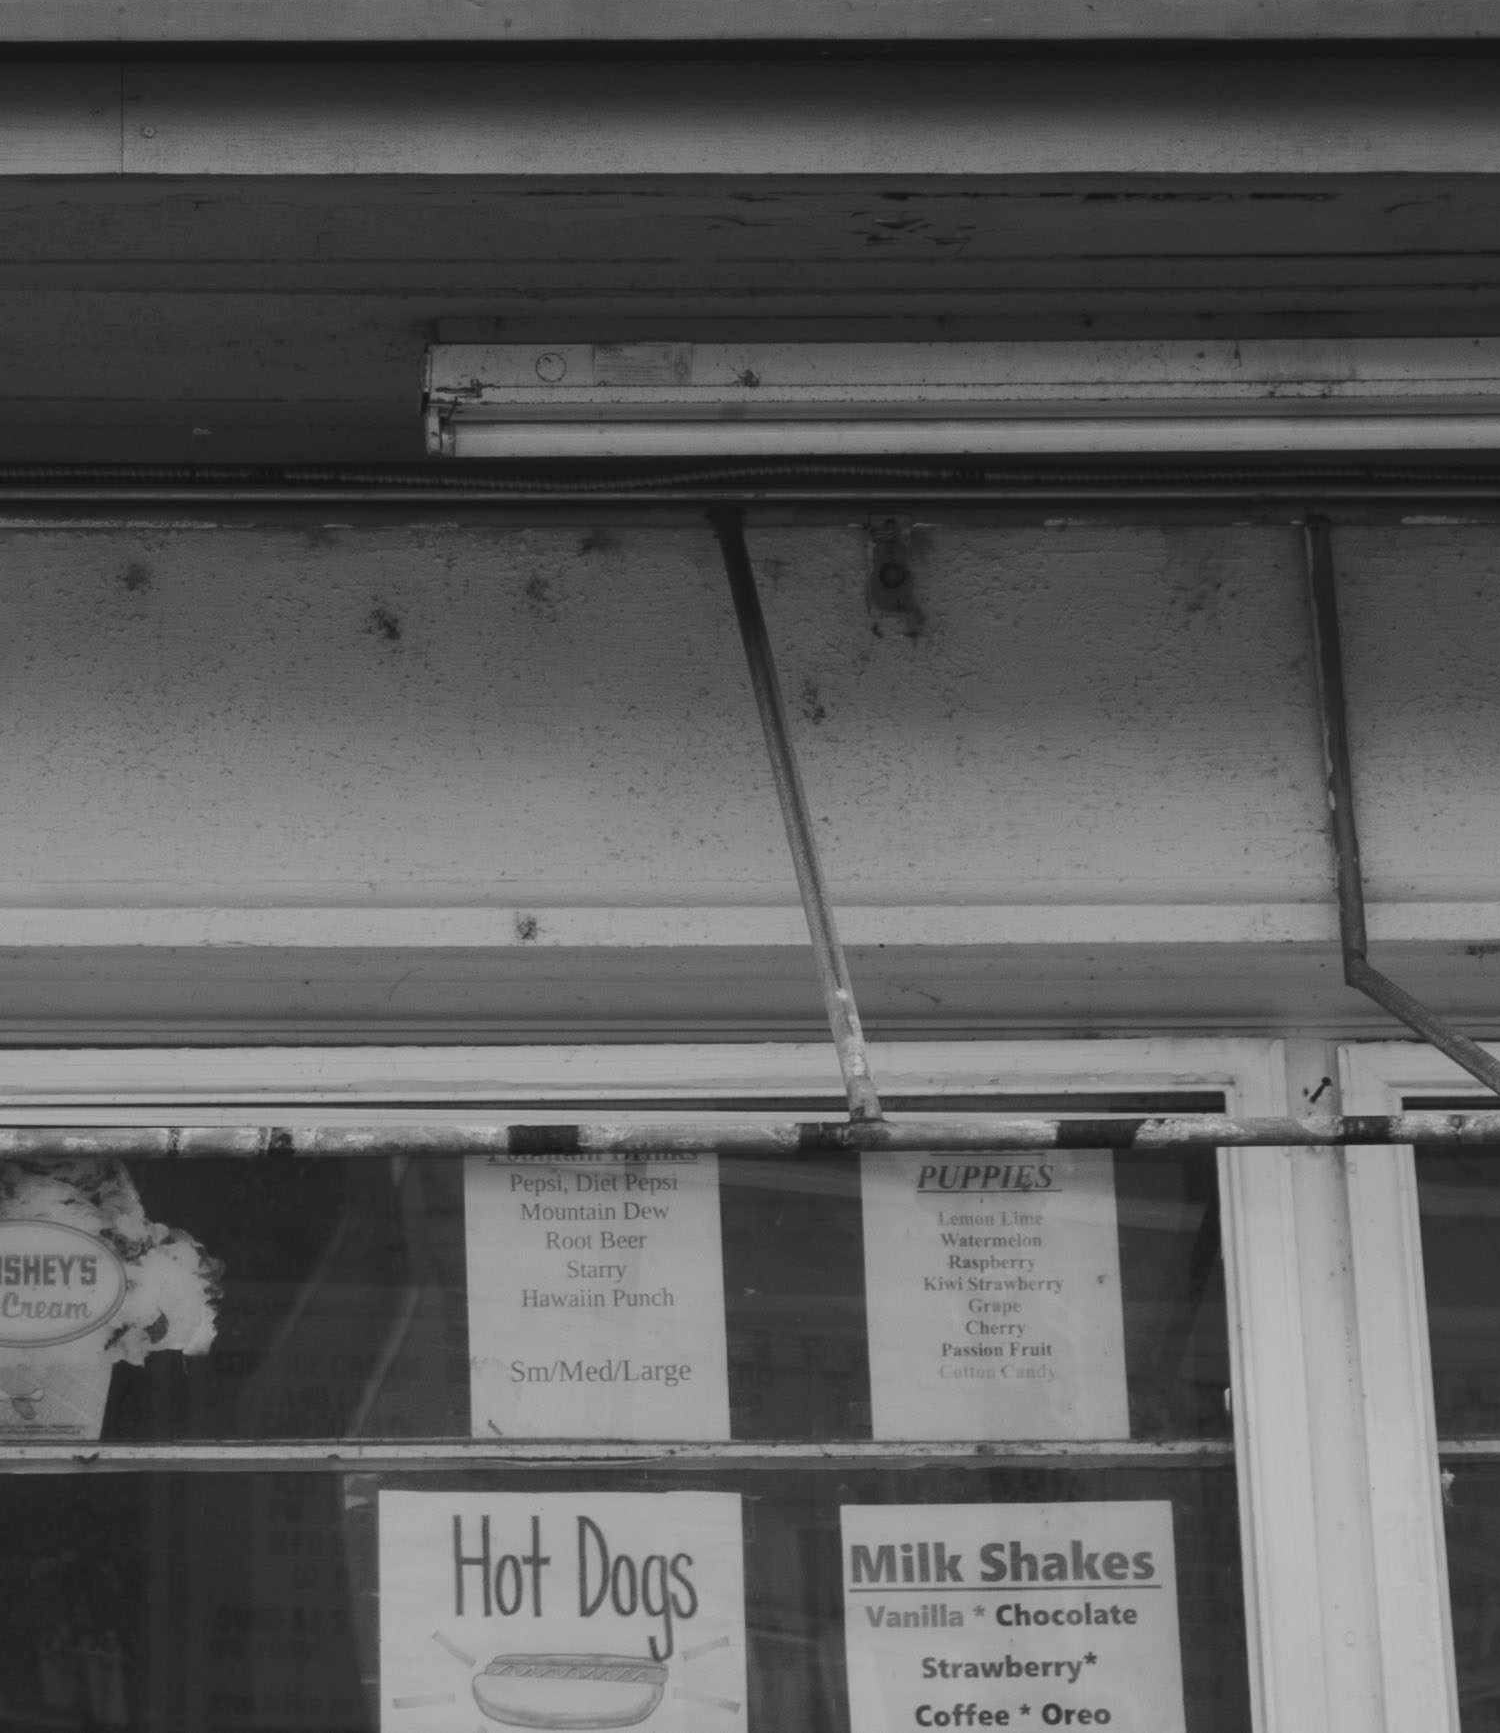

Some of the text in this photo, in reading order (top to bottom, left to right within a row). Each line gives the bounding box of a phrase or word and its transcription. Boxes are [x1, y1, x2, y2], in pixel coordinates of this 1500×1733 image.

[510, 1173, 679, 1196] Pepsi, Diet Pepsi
[917, 1164, 1054, 1190] PUPPIES
[520, 1201, 670, 1221] Mountain Dew
[938, 1211, 1043, 1226] Lemon Lime
[546, 1230, 648, 1250] Root Beer
[940, 1233, 1042, 1247] Watermelon
[567, 1260, 627, 1283] Starry
[948, 1254, 1036, 1272] Raspberry
[923, 1276, 1064, 1294] Kiwi Strawberry
[2, 1291, 93, 1319] Cream
[521, 1287, 675, 1308] Hawaiin Punch
[968, 1298, 1022, 1316] Grape
[965, 1320, 1025, 1338] Cherry
[941, 1341, 1053, 1357] Passion Fruit
[510, 1360, 692, 1387] Sm/Med/Large
[939, 1364, 1056, 1382] Cotton Candy
[851, 1539, 1155, 1583] Milk Shakes
[453, 1514, 551, 1617] Hot
[576, 1514, 699, 1663] Dogs
[865, 1601, 1138, 1628] Vanilla Chocolate
[915, 1702, 1112, 1727] Coffee Oreo
